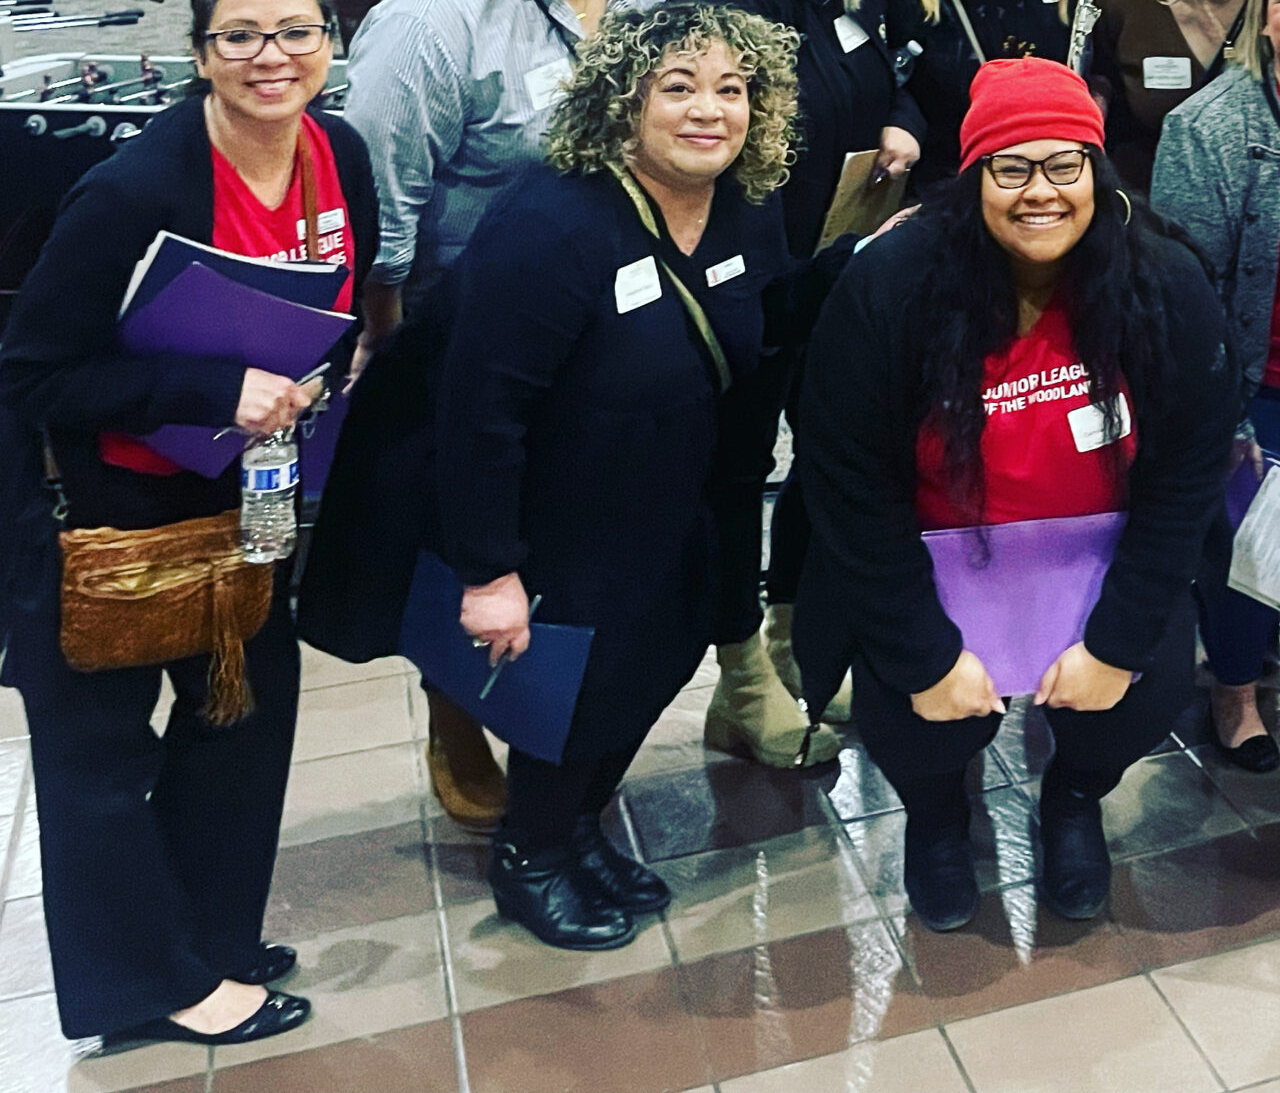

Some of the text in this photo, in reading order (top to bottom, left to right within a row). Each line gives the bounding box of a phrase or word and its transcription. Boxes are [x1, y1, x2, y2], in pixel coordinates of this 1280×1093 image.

[982, 363, 1089, 400] JUNIOR LEAG
[1000, 396, 1026, 414] THE
[1028, 380, 1092, 405] WOODLAN
